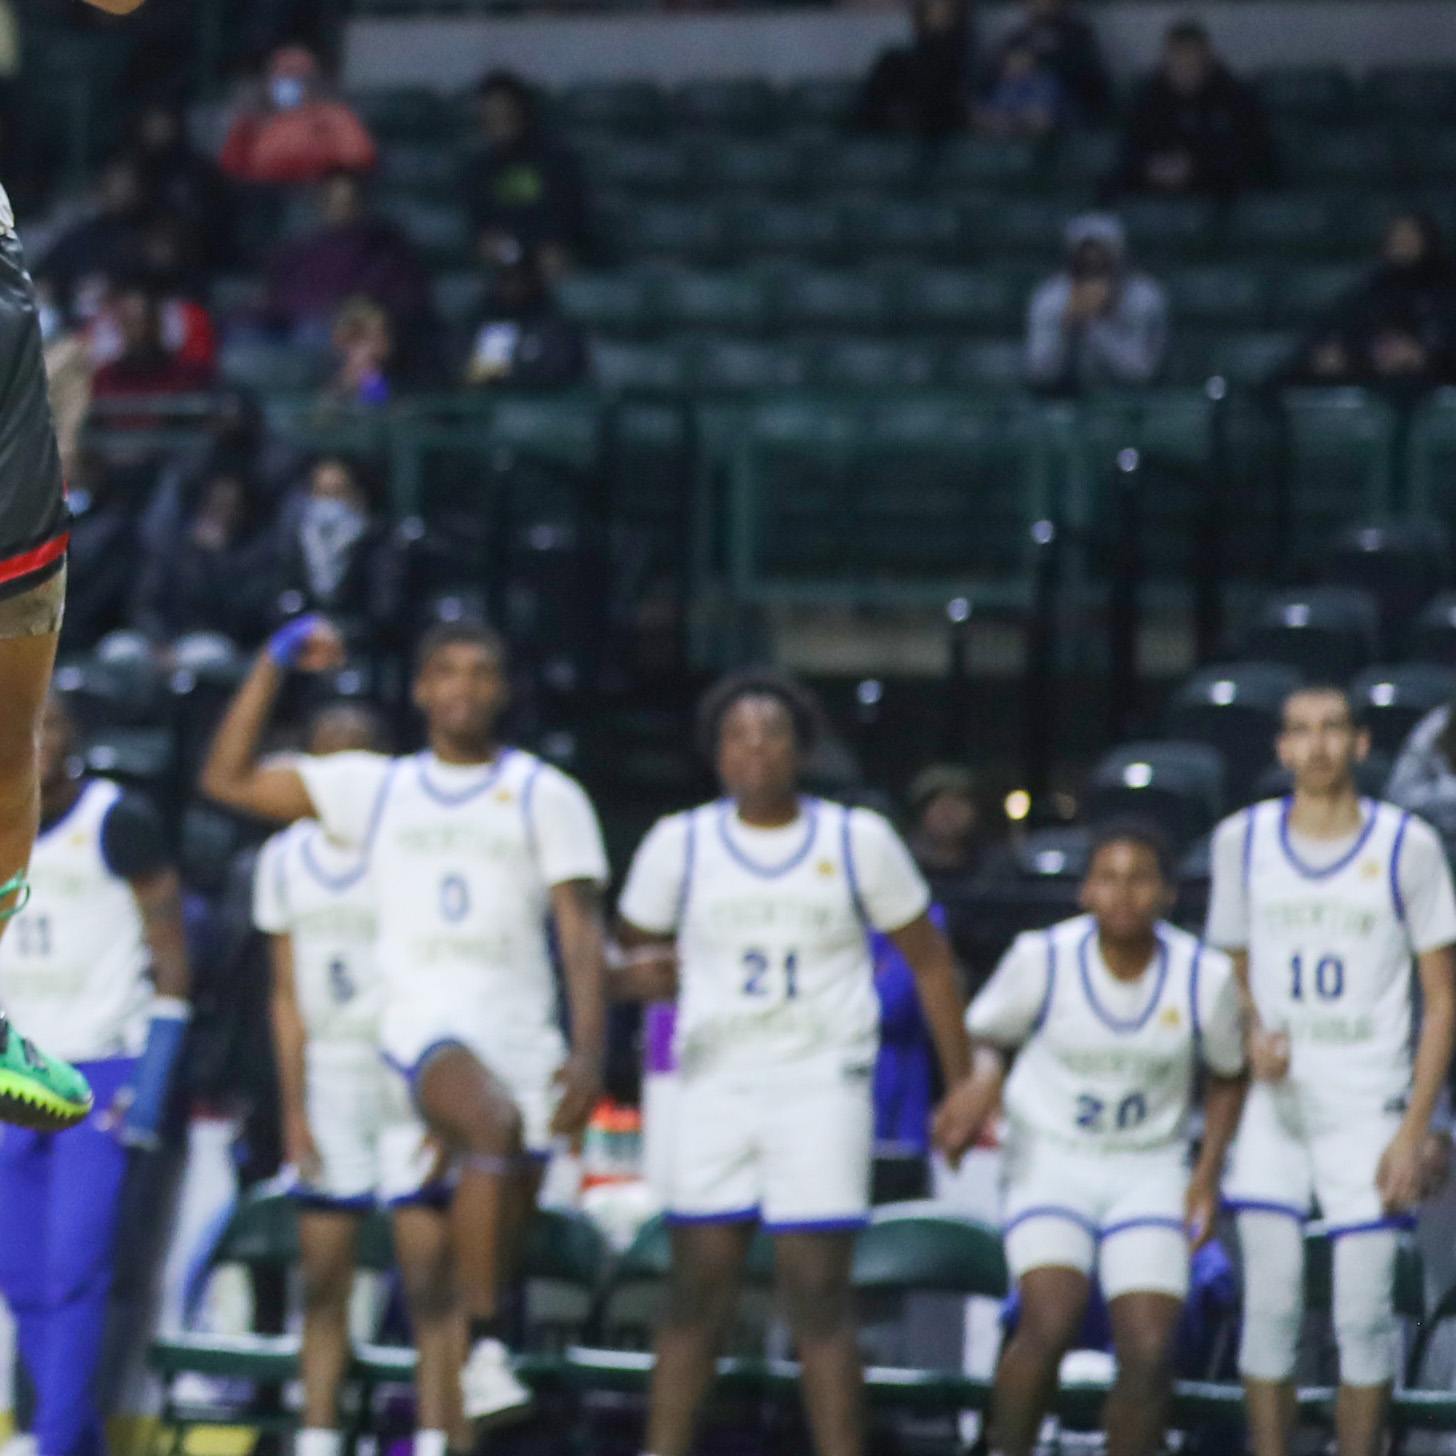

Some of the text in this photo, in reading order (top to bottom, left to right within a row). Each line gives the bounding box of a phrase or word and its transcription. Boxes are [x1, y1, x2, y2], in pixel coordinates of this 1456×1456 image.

[439, 874, 471, 924] 0
[741, 948, 799, 1000] 21
[1291, 952, 1345, 1002] 10
[1076, 1089, 1148, 1130] 20
